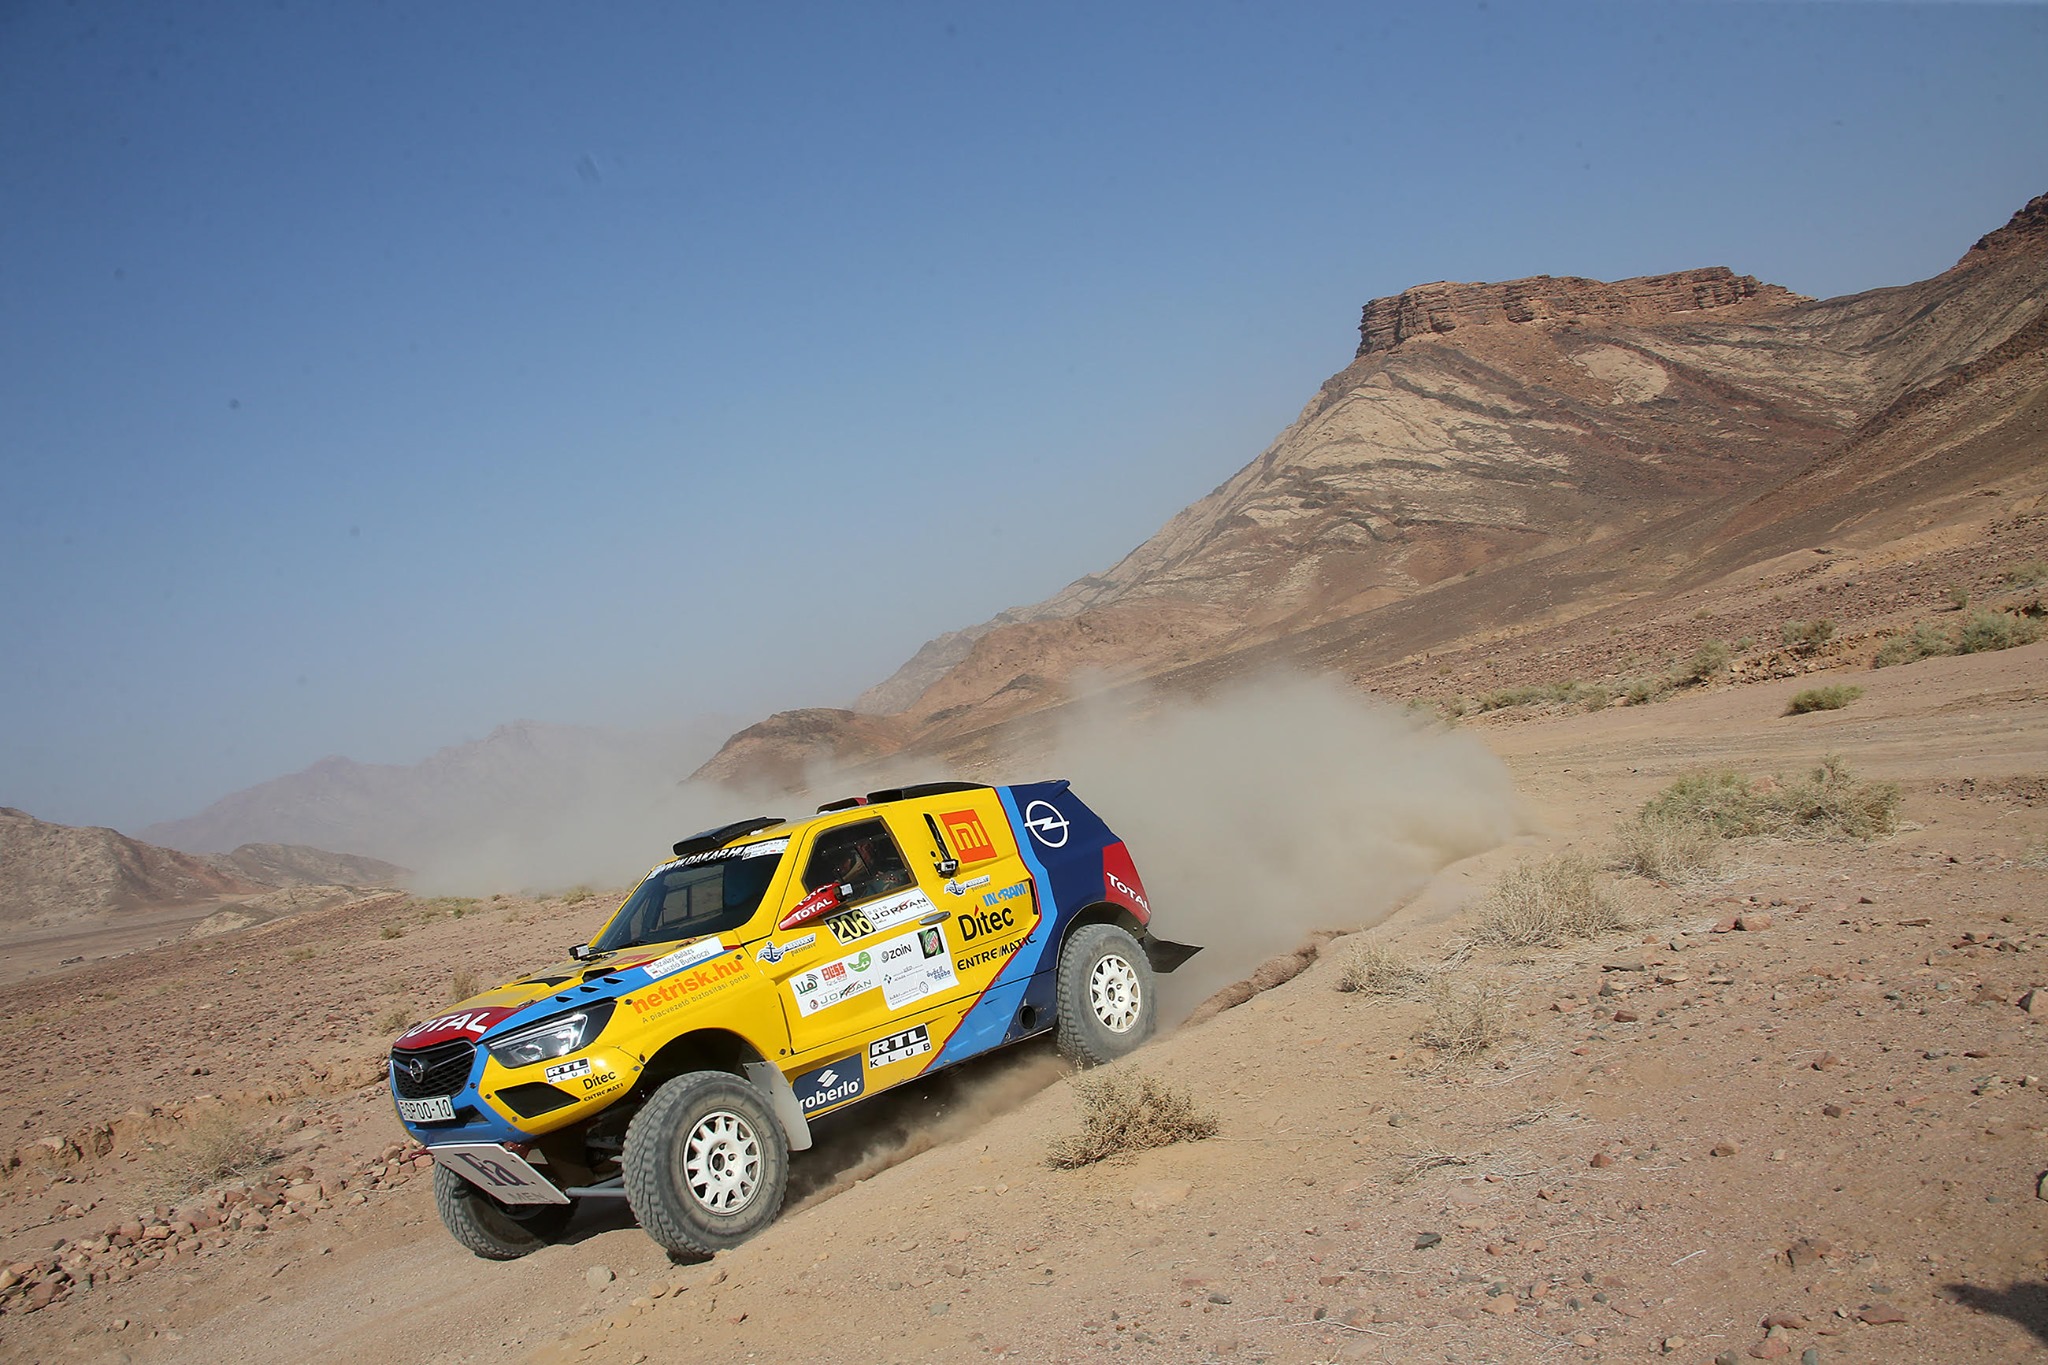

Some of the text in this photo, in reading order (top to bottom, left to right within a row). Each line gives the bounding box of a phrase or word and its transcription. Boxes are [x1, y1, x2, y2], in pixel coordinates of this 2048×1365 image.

[1106, 872, 1151, 914] TOTAL
[793, 898, 833, 921] TOTAL
[872, 898, 927, 921] JORDAN
[828, 911, 874, 943] 206
[632, 958, 744, 1015] netrisk.hu
[870, 1042, 931, 1068] KLUB
[871, 1030, 926, 1056] RTL
[547, 1060, 588, 1077] RTL
[800, 1080, 859, 1110] roberlo
[454, 1152, 530, 1186] Fa
